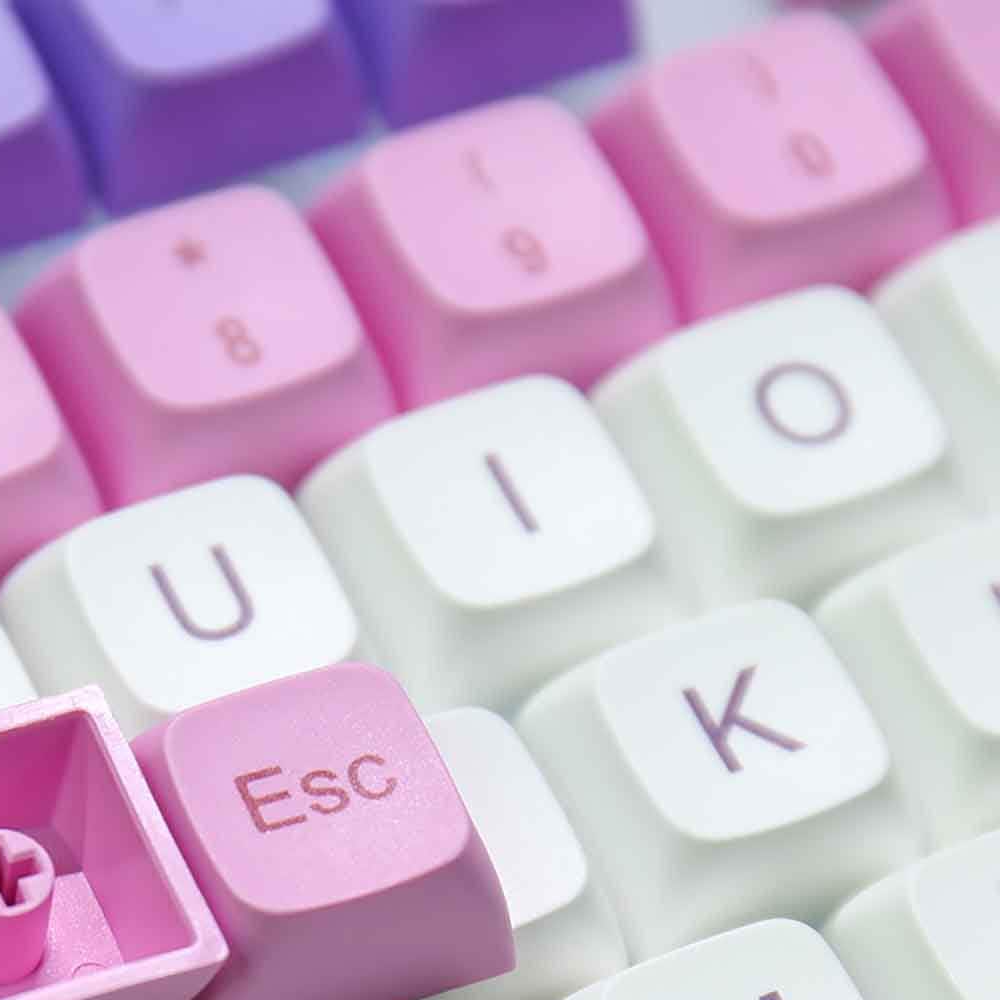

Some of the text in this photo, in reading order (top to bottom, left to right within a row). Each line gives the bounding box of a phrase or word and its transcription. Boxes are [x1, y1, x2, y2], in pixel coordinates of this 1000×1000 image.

[501, 227, 548, 274] 9
[215, 317, 261, 365] 8
[755, 361, 850, 444] O
[485, 453, 540, 533] I
[149, 544, 254, 640] U
[682, 664, 805, 773] K
[234, 754, 397, 832] Esc
